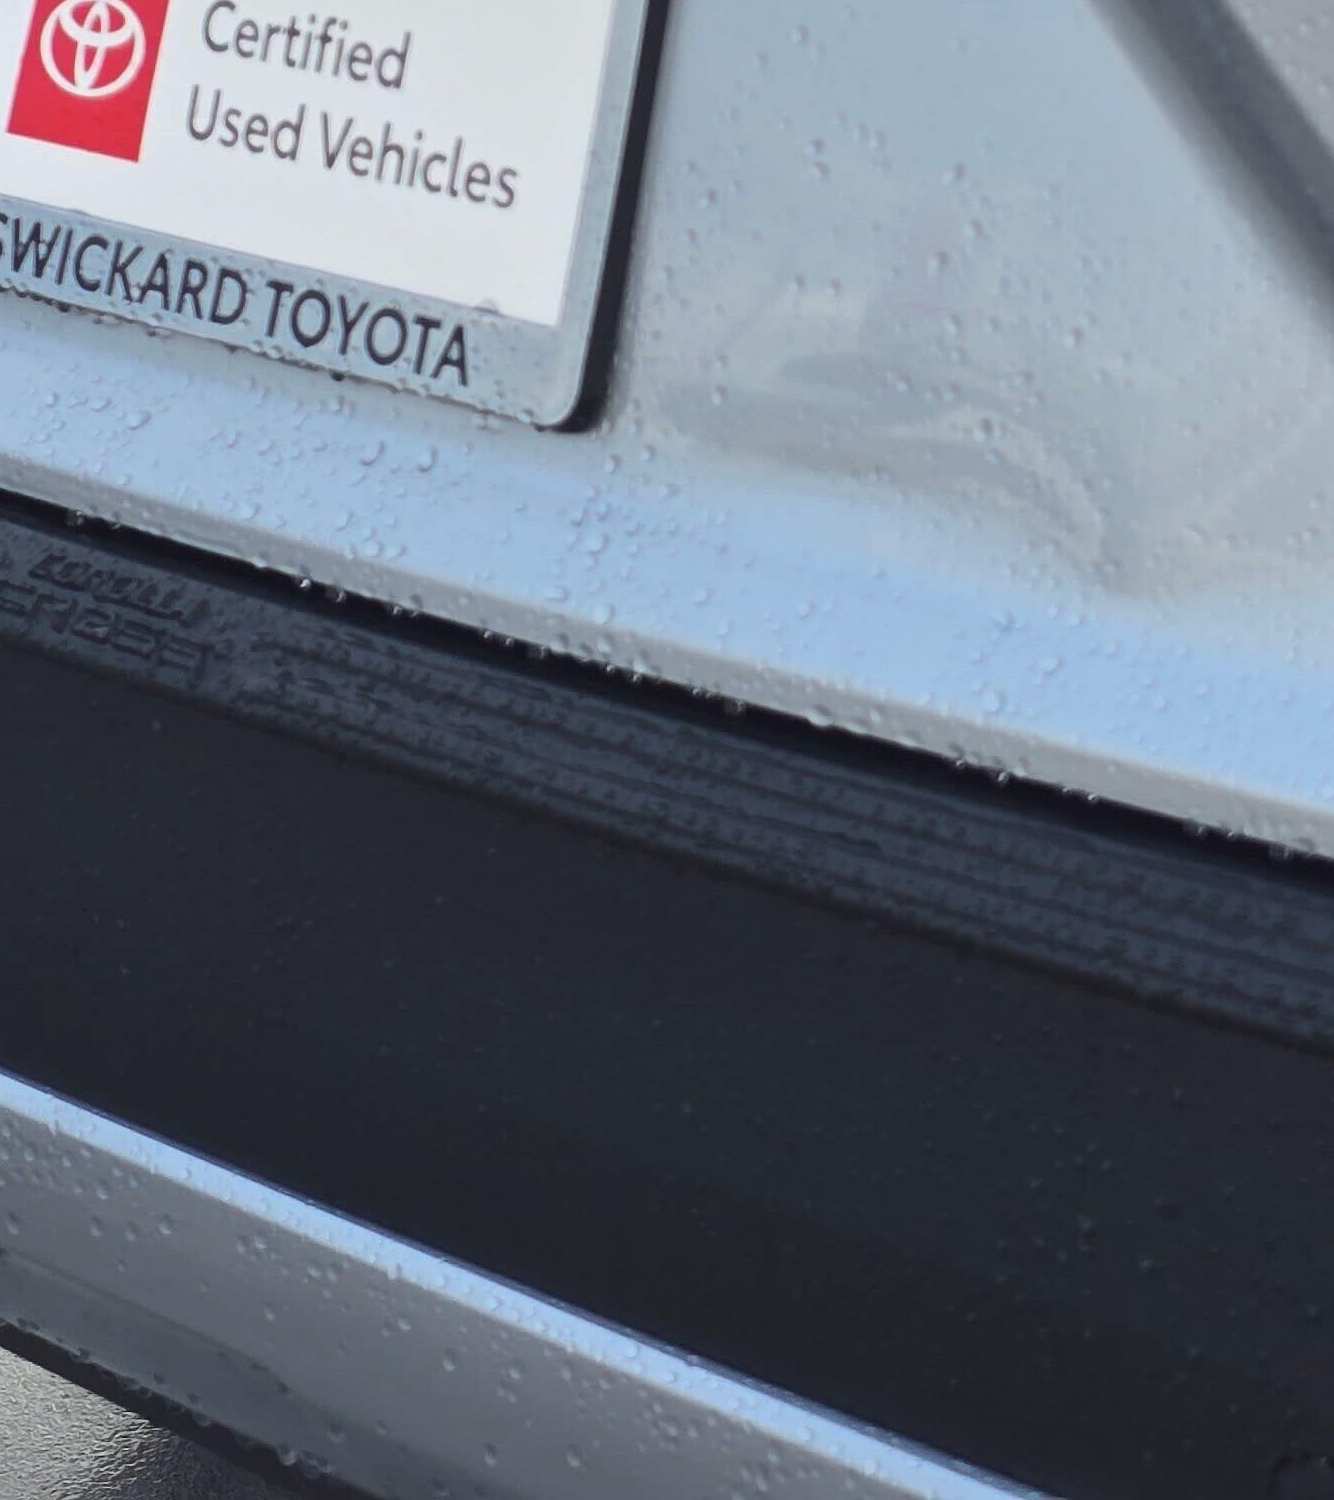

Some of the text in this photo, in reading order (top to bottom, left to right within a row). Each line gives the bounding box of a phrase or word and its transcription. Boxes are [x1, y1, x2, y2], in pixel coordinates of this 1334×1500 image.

[186, 84, 519, 209] Used Vehicles
[266, 280, 468, 387] TOYOTA
